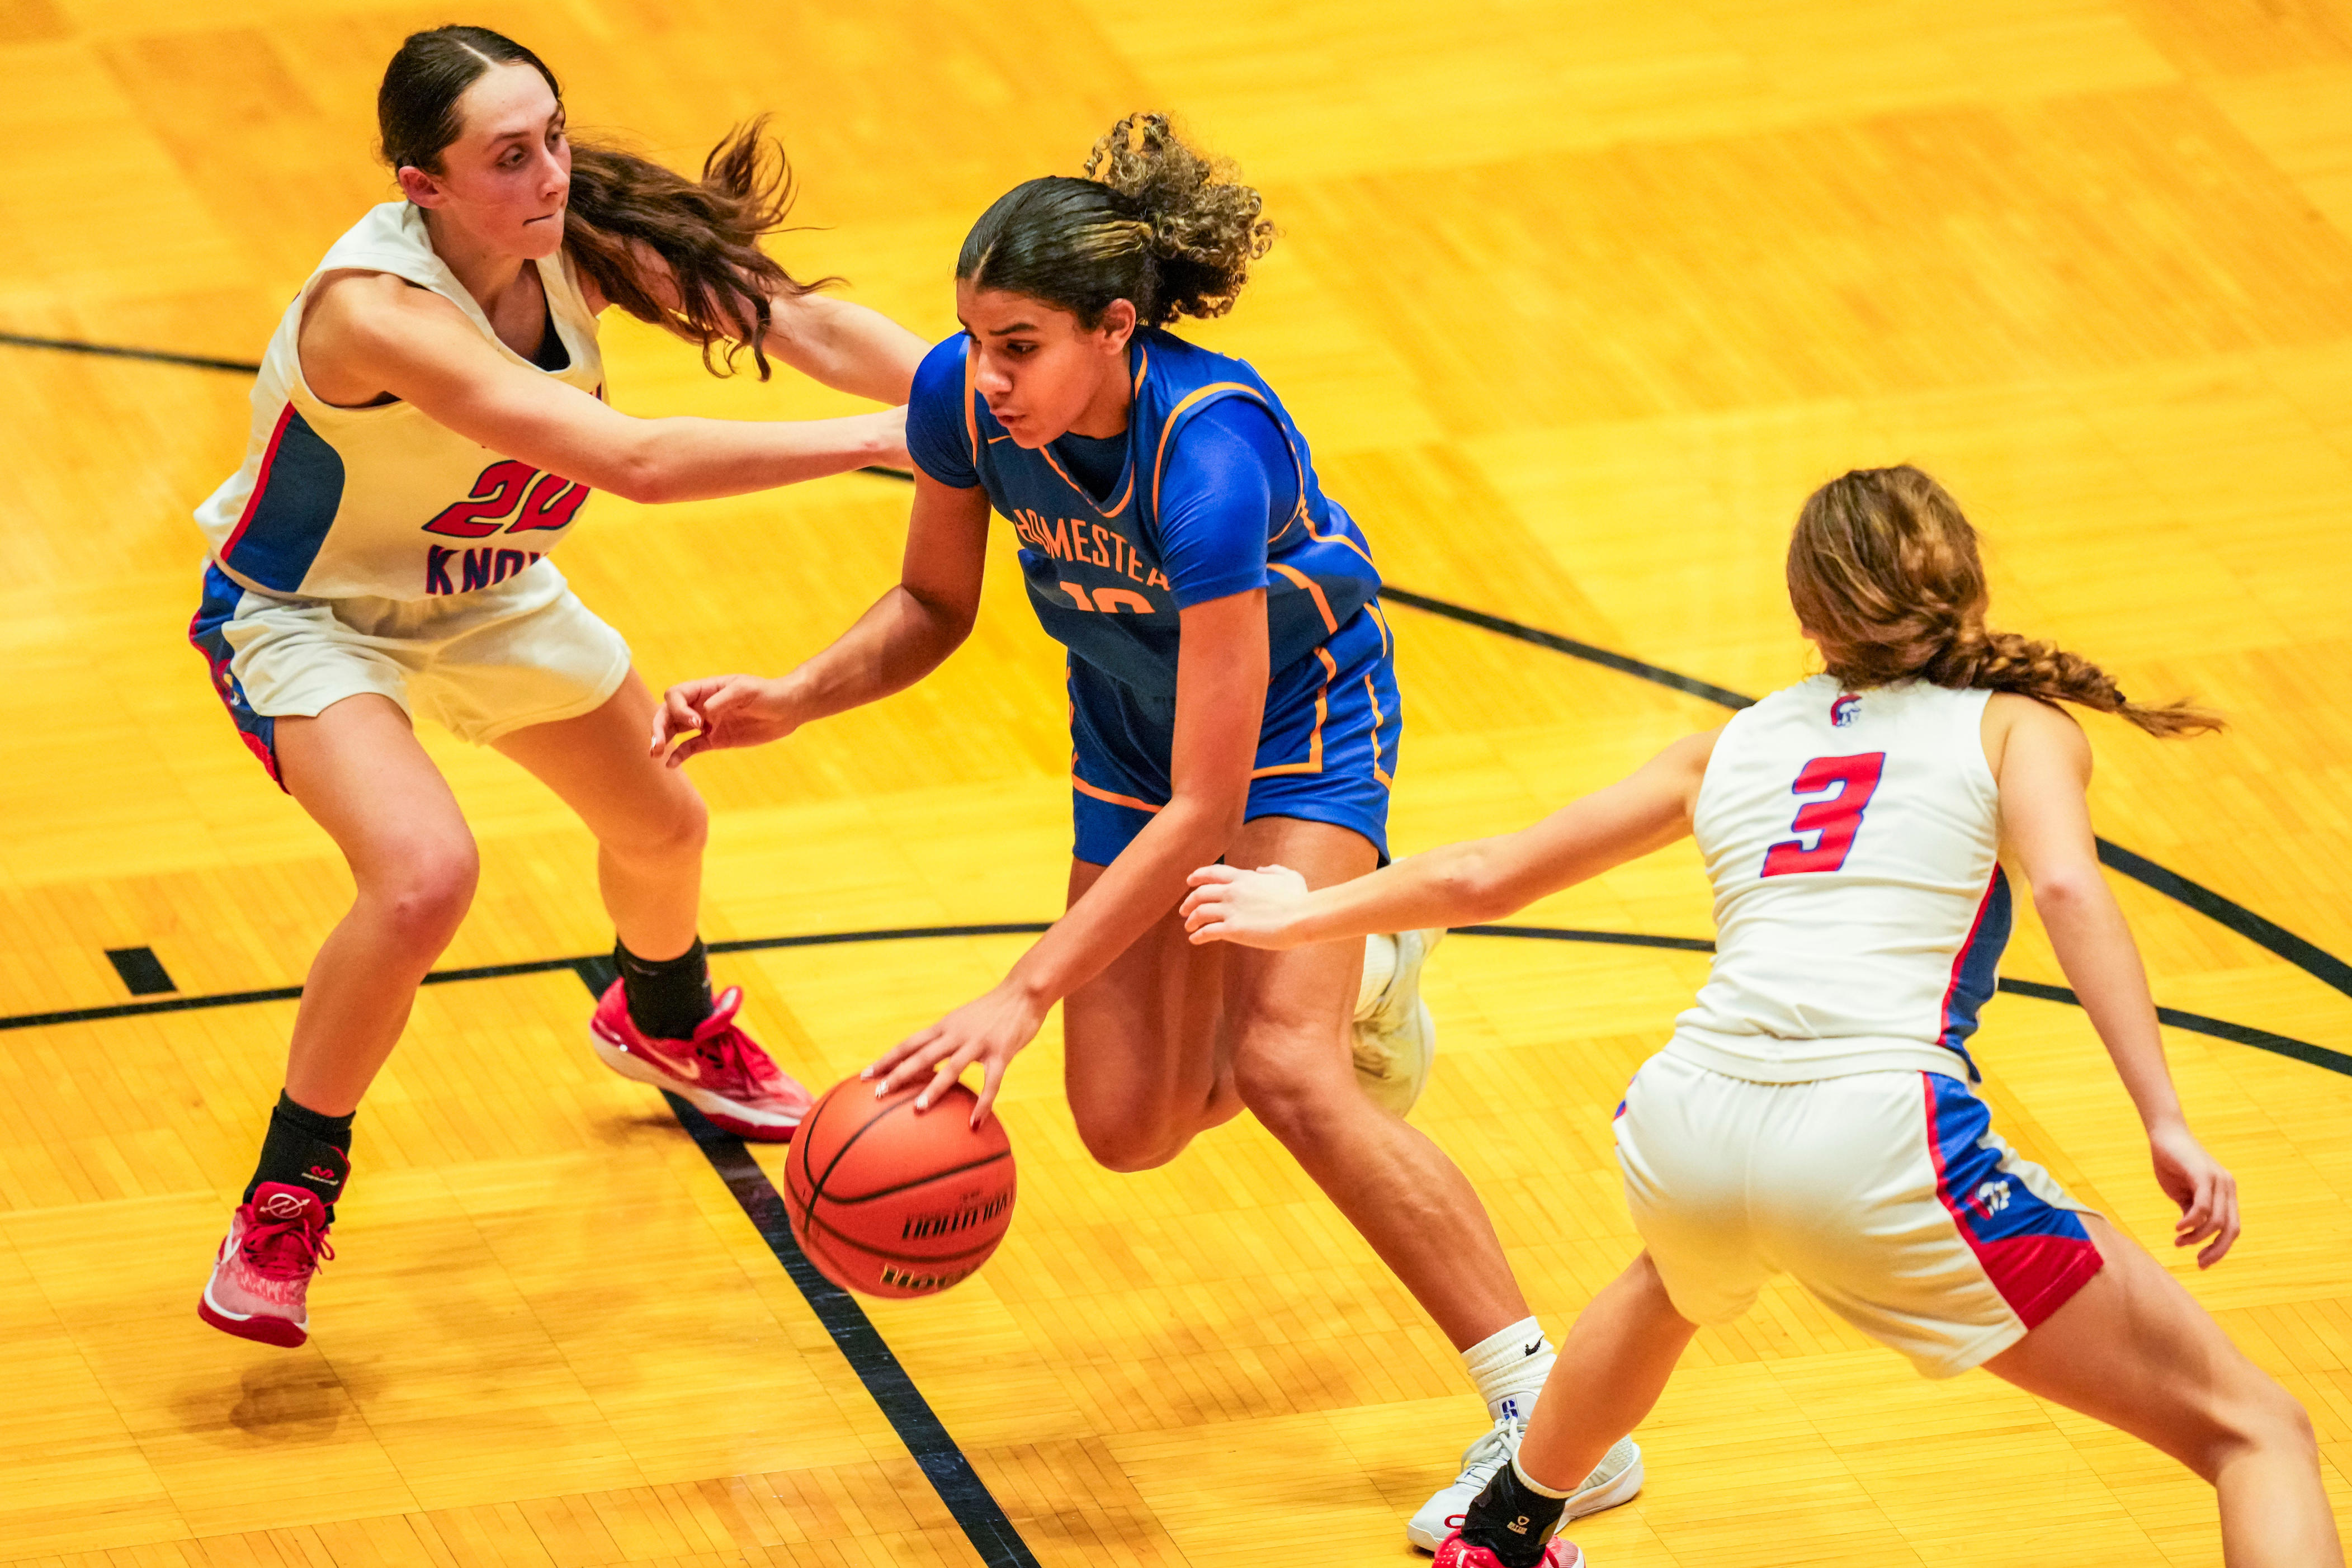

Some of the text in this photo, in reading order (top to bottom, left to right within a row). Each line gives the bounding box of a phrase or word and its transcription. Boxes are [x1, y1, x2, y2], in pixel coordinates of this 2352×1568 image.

[421, 460, 591, 538] 20
[426, 544, 540, 595] KNO
[1760, 751, 1887, 879] 3
